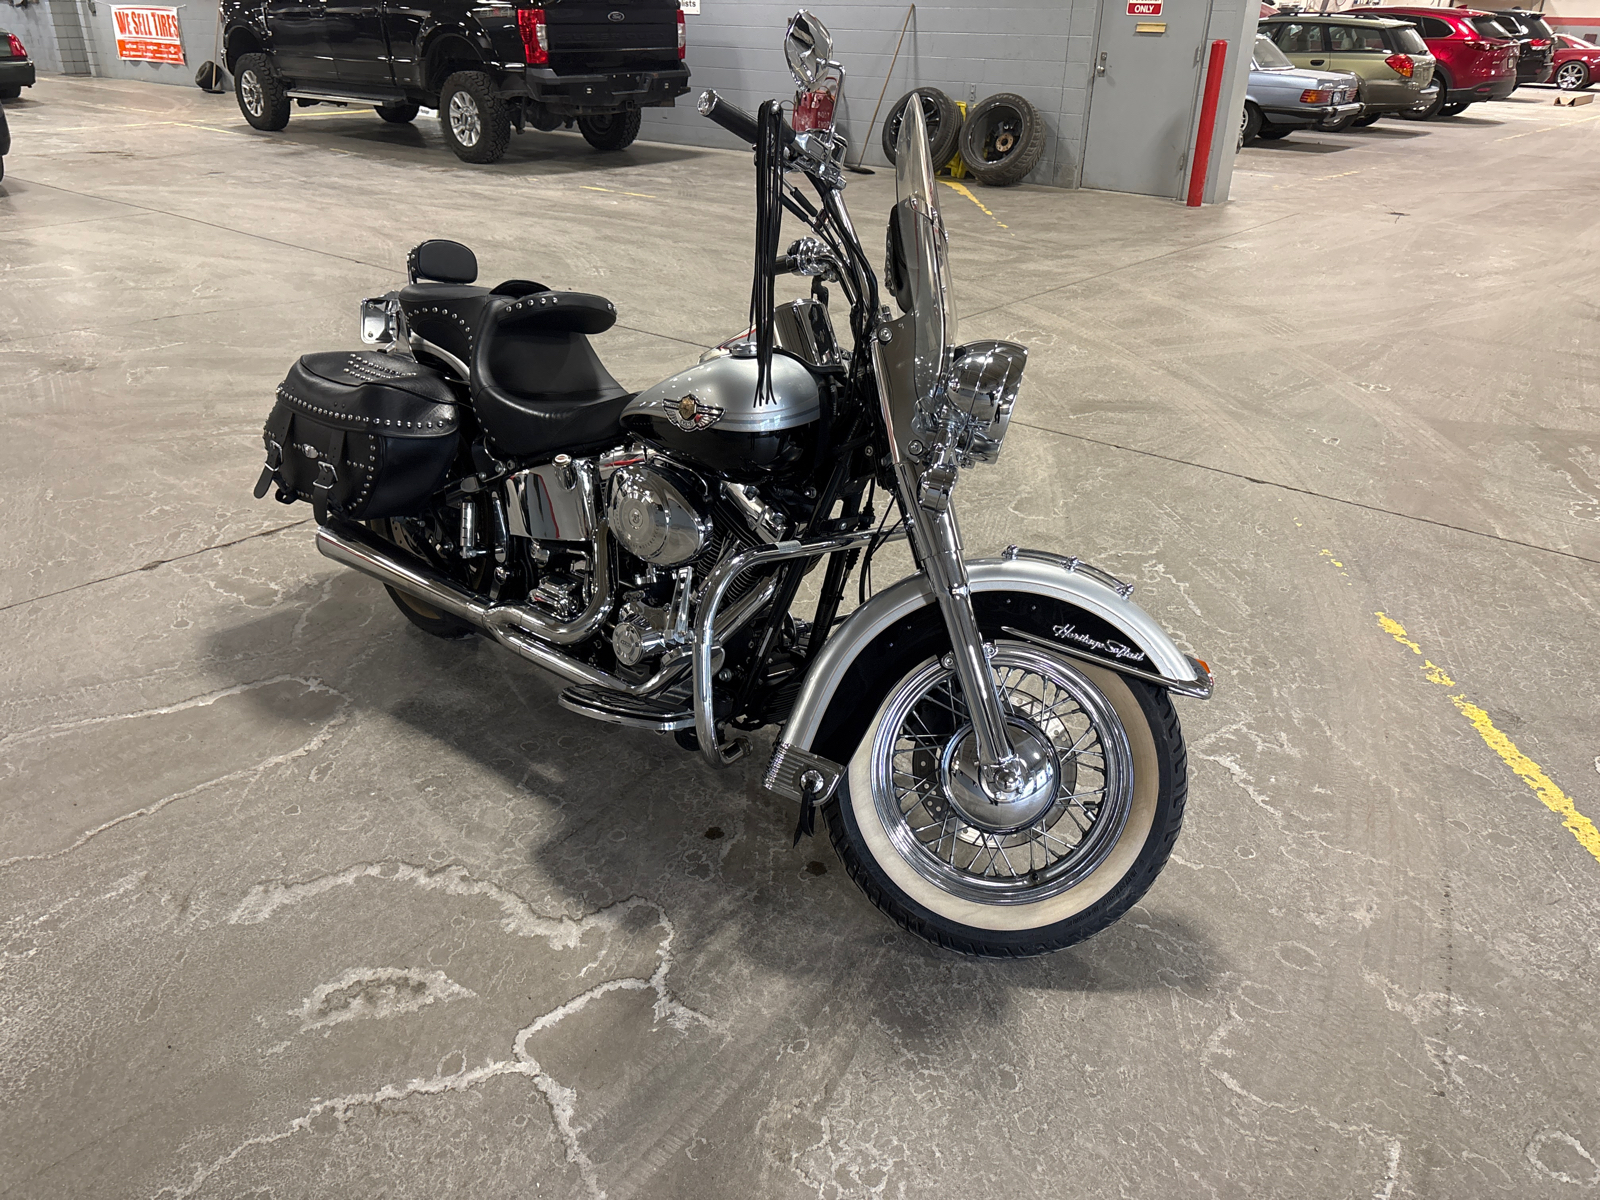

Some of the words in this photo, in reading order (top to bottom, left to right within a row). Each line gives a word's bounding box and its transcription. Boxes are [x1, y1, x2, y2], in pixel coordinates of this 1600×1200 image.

[1134, 5, 1154, 13] ONLY
[114, 11, 132, 35] WE
[131, 11, 152, 36] SELL
[150, 12, 178, 38] TIRES
[1052, 623, 1104, 650] Heritage
[1104, 639, 1145, 661] Softail
